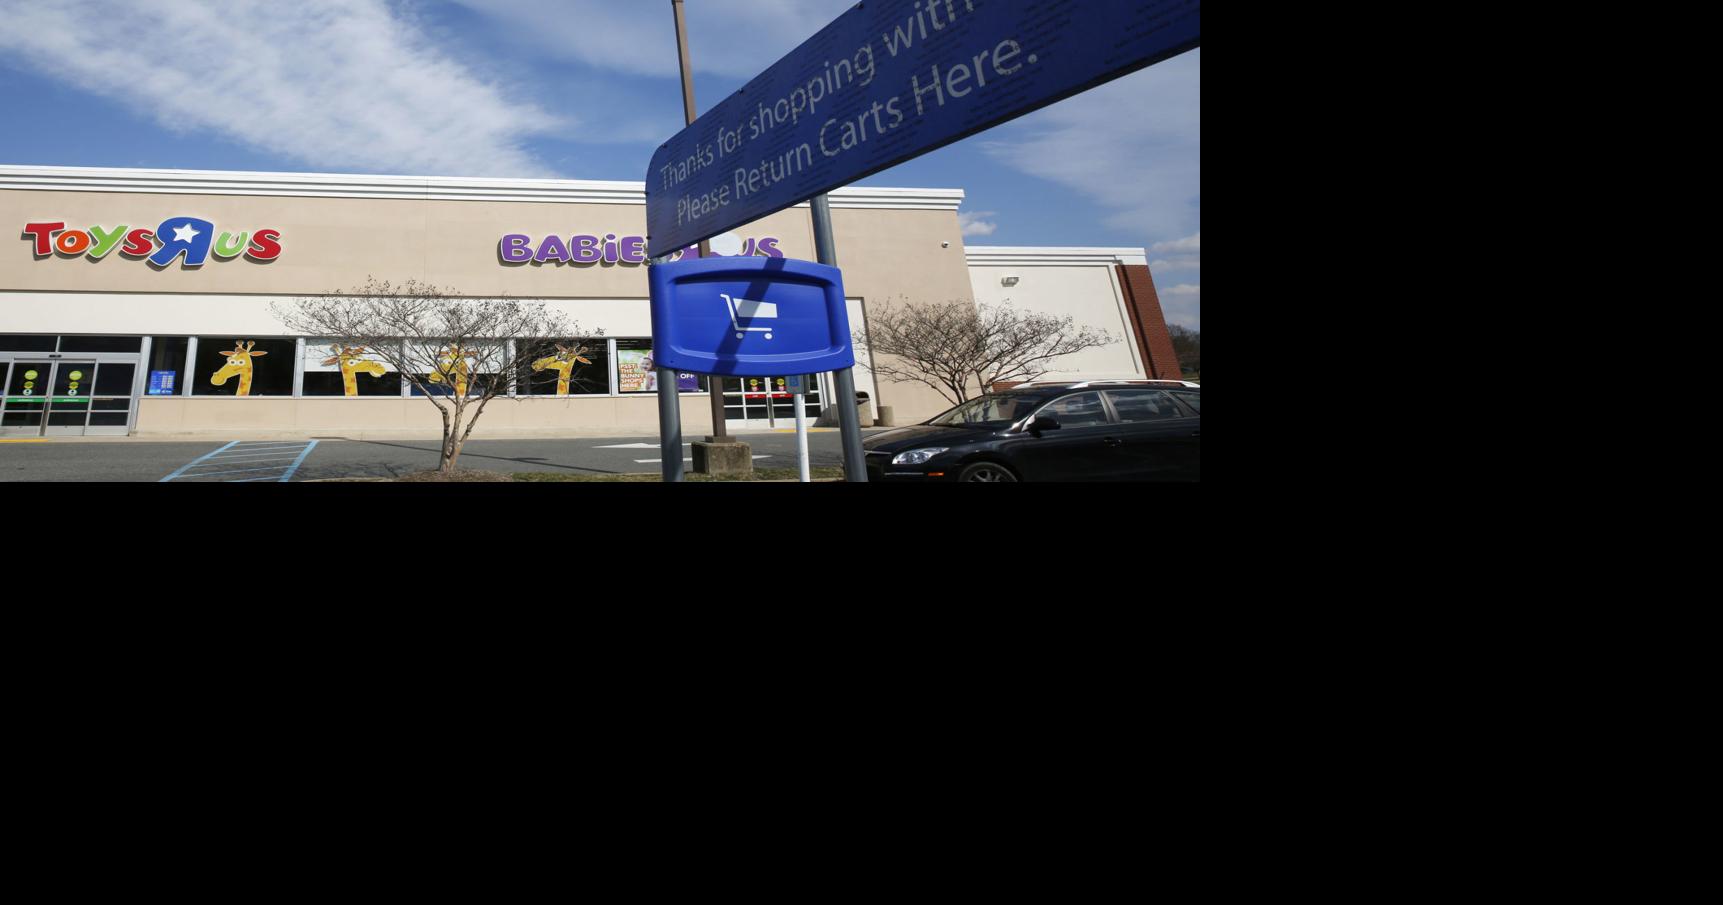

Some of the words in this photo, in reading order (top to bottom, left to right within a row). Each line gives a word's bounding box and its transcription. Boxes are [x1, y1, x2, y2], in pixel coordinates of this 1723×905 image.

[660, 143, 714, 191] Thanks
[717, 123, 744, 158] for
[749, 44, 876, 140] shopping
[677, 185, 731, 227] Please
[734, 143, 812, 200] Return
[819, 96, 904, 157] Carts
[911, 39, 1038, 116] Here.
